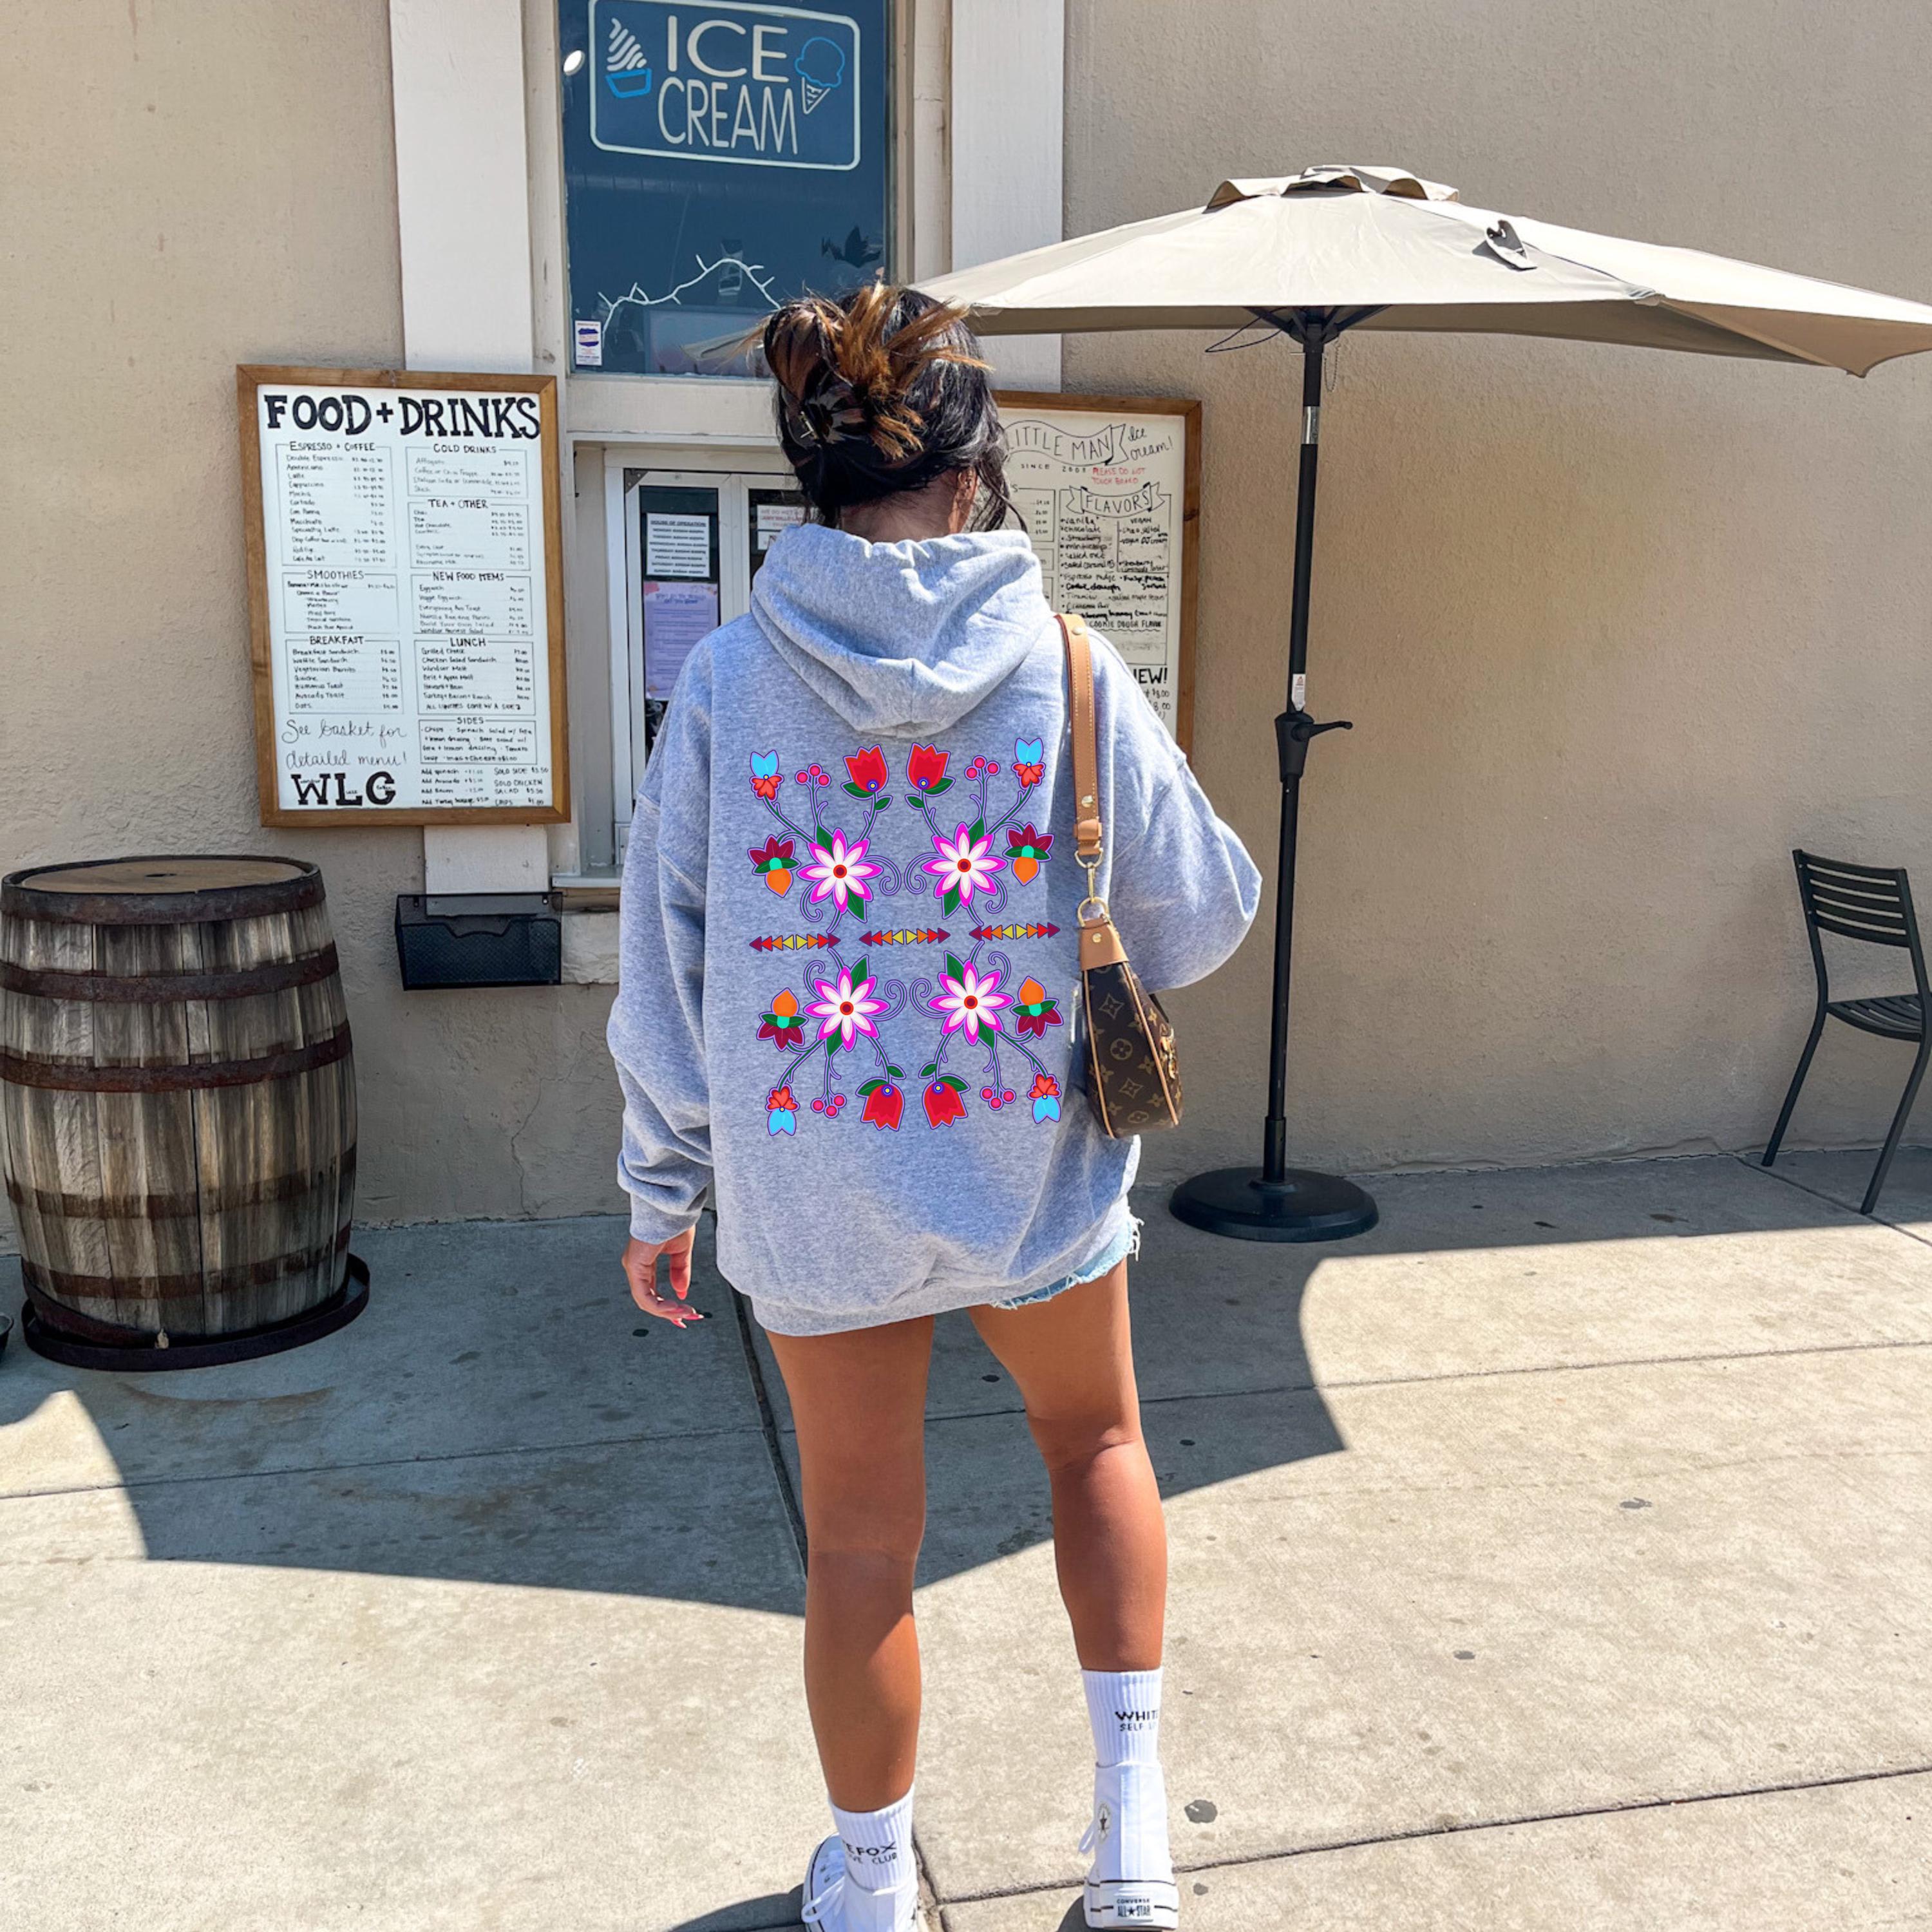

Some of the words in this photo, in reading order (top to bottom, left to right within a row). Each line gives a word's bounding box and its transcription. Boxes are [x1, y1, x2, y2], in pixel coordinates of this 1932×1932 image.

[667, 15, 790, 82] ICE
[658, 77, 798, 155] CREAM
[344, 442, 375, 451] COFFEE
[433, 444, 460, 453] COLD
[464, 445, 497, 453] DRINKS
[1007, 426, 1063, 455] LITTLE
[1072, 435, 1110, 460] MAN
[428, 499, 448, 507] TEA
[458, 499, 488, 508] OTHER
[1086, 490, 1149, 513] FLAVORS
[307, 570, 365, 580] SMOOTHIES
[433, 572, 453, 581] NEW
[457, 572, 475, 580] FOOD
[479, 573, 504, 582] ITEMS
[450, 638, 486, 647] LUNCH
[281, 719, 311, 744] See
[319, 719, 374, 738] basket
[380, 724, 407, 748] for
[287, 750, 350, 770] detailed
[358, 752, 406, 766] menu!
[872, 1852, 897, 1864] CLUB
[1137, 1906, 1150, 1917] STAR
